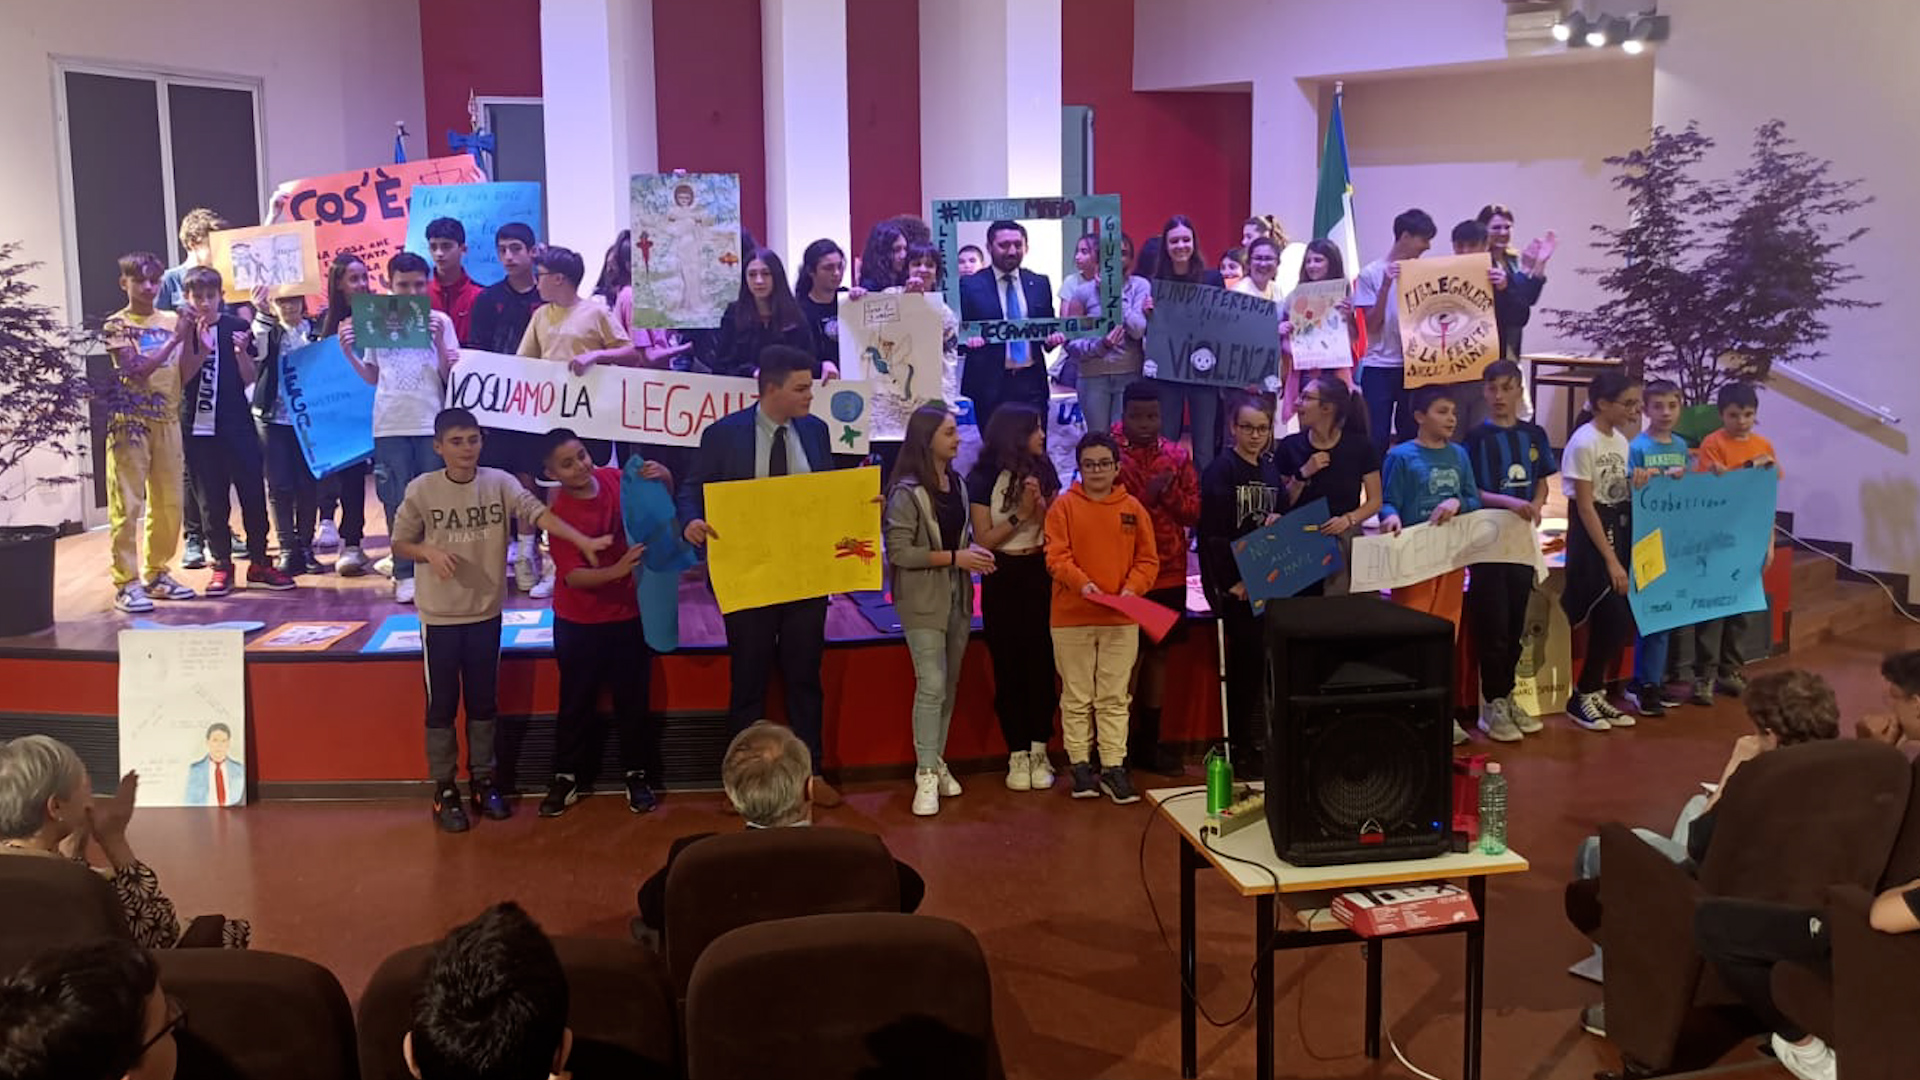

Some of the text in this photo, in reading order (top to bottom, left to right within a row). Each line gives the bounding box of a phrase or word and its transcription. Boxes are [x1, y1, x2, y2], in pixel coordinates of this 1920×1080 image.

[291, 168, 405, 225] COS'È
[451, 371, 555, 417] VOGLIAMO
[560, 382, 592, 418] LA
[429, 503, 503, 529] PARIS
